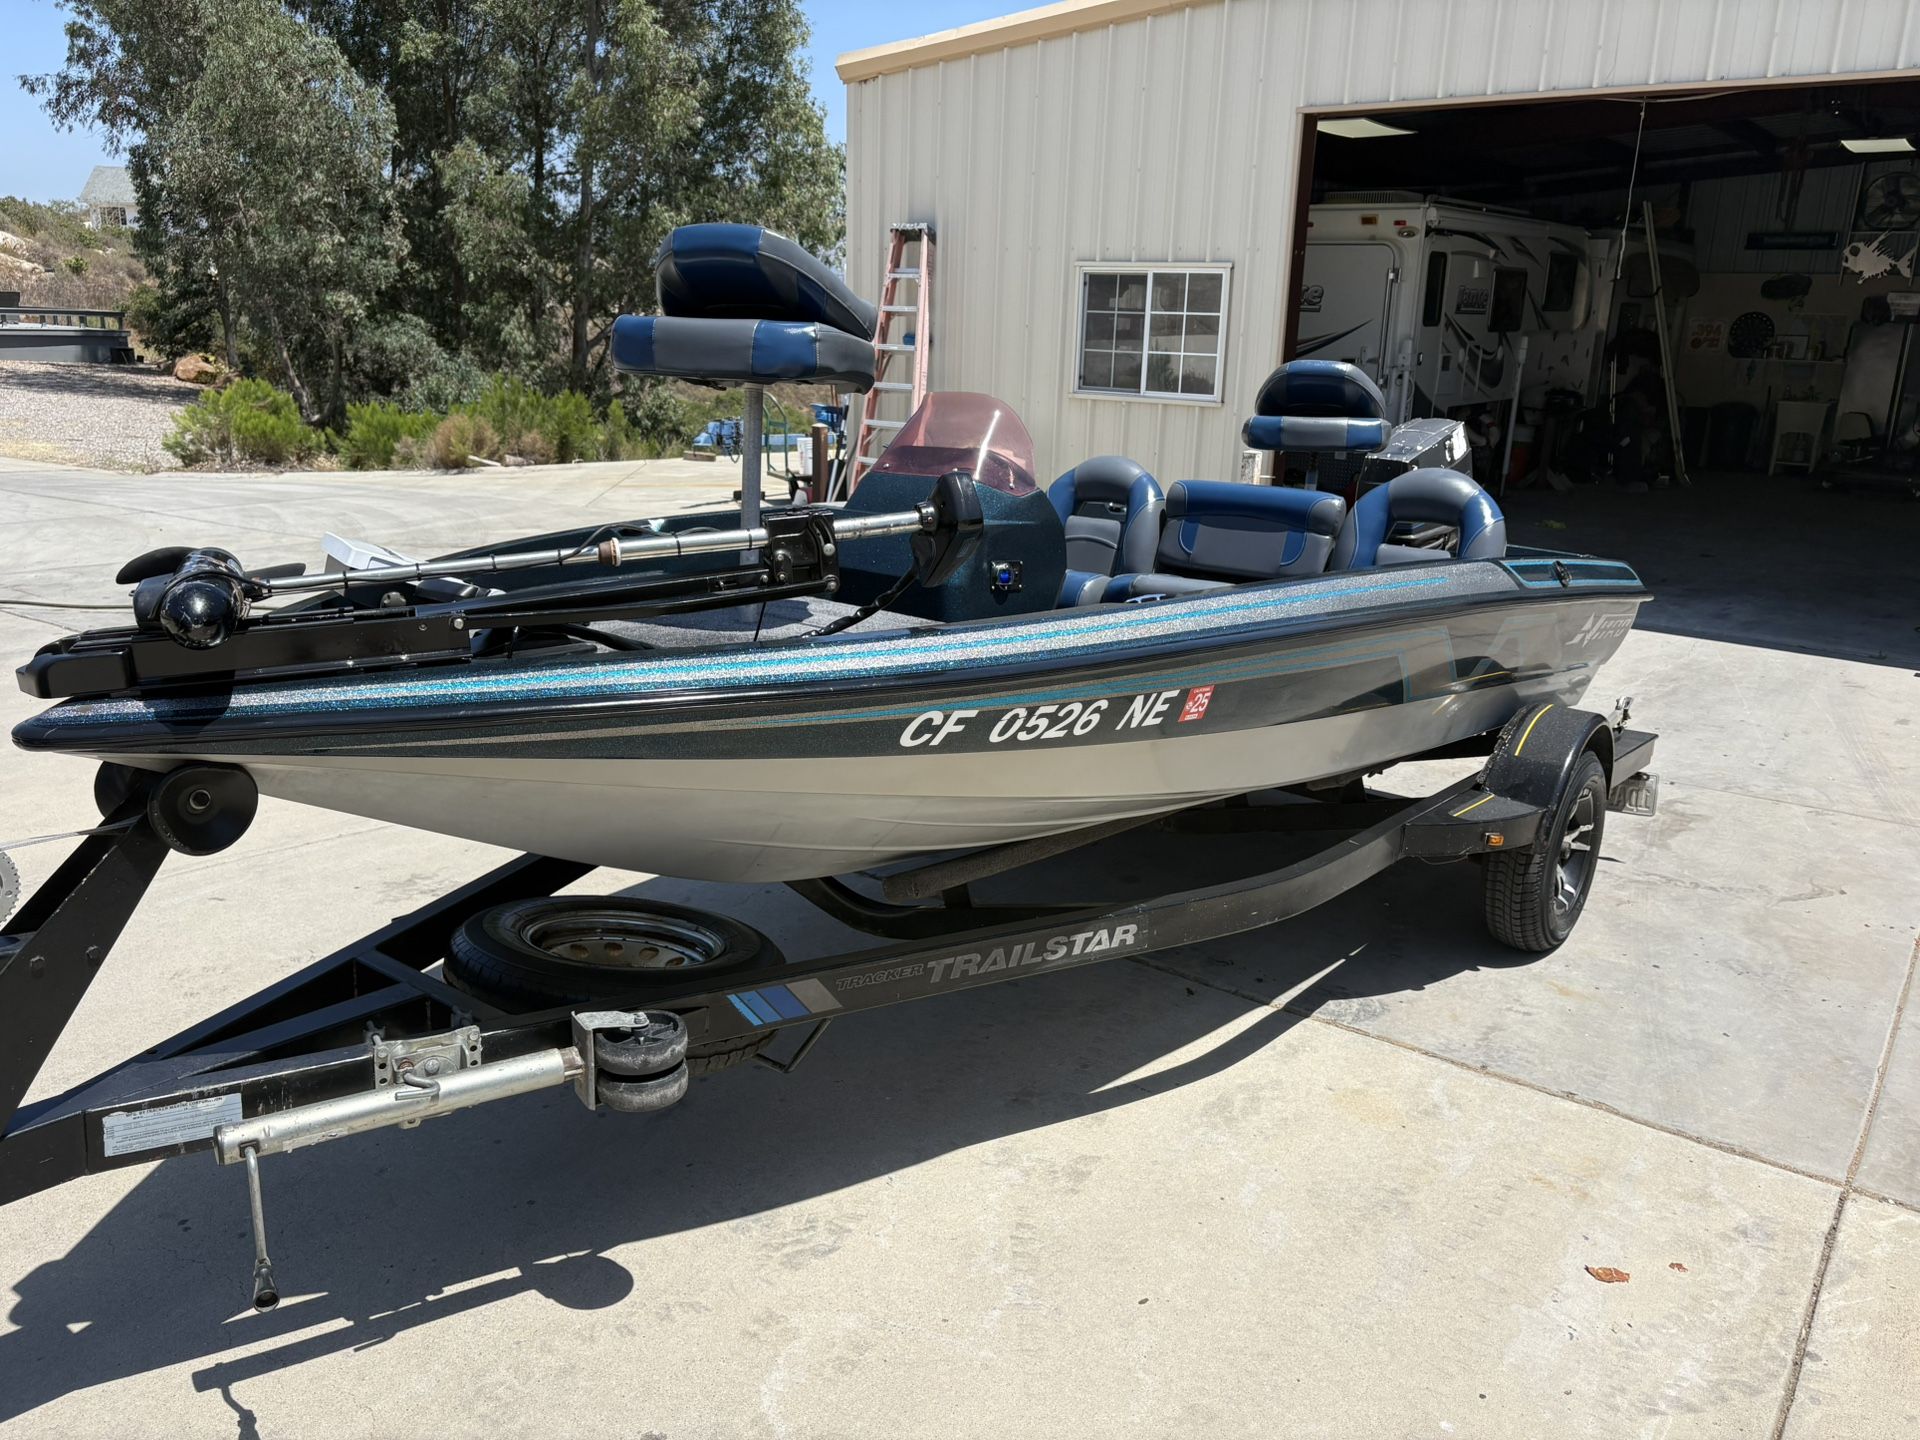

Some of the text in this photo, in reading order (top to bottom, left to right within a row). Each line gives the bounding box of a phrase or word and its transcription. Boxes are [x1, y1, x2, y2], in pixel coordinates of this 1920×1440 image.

[899, 689, 1181, 747] CF 0526 NE
[1190, 692, 1212, 713] 25
[836, 923, 1138, 991] TRACKER TRAILSTAR
